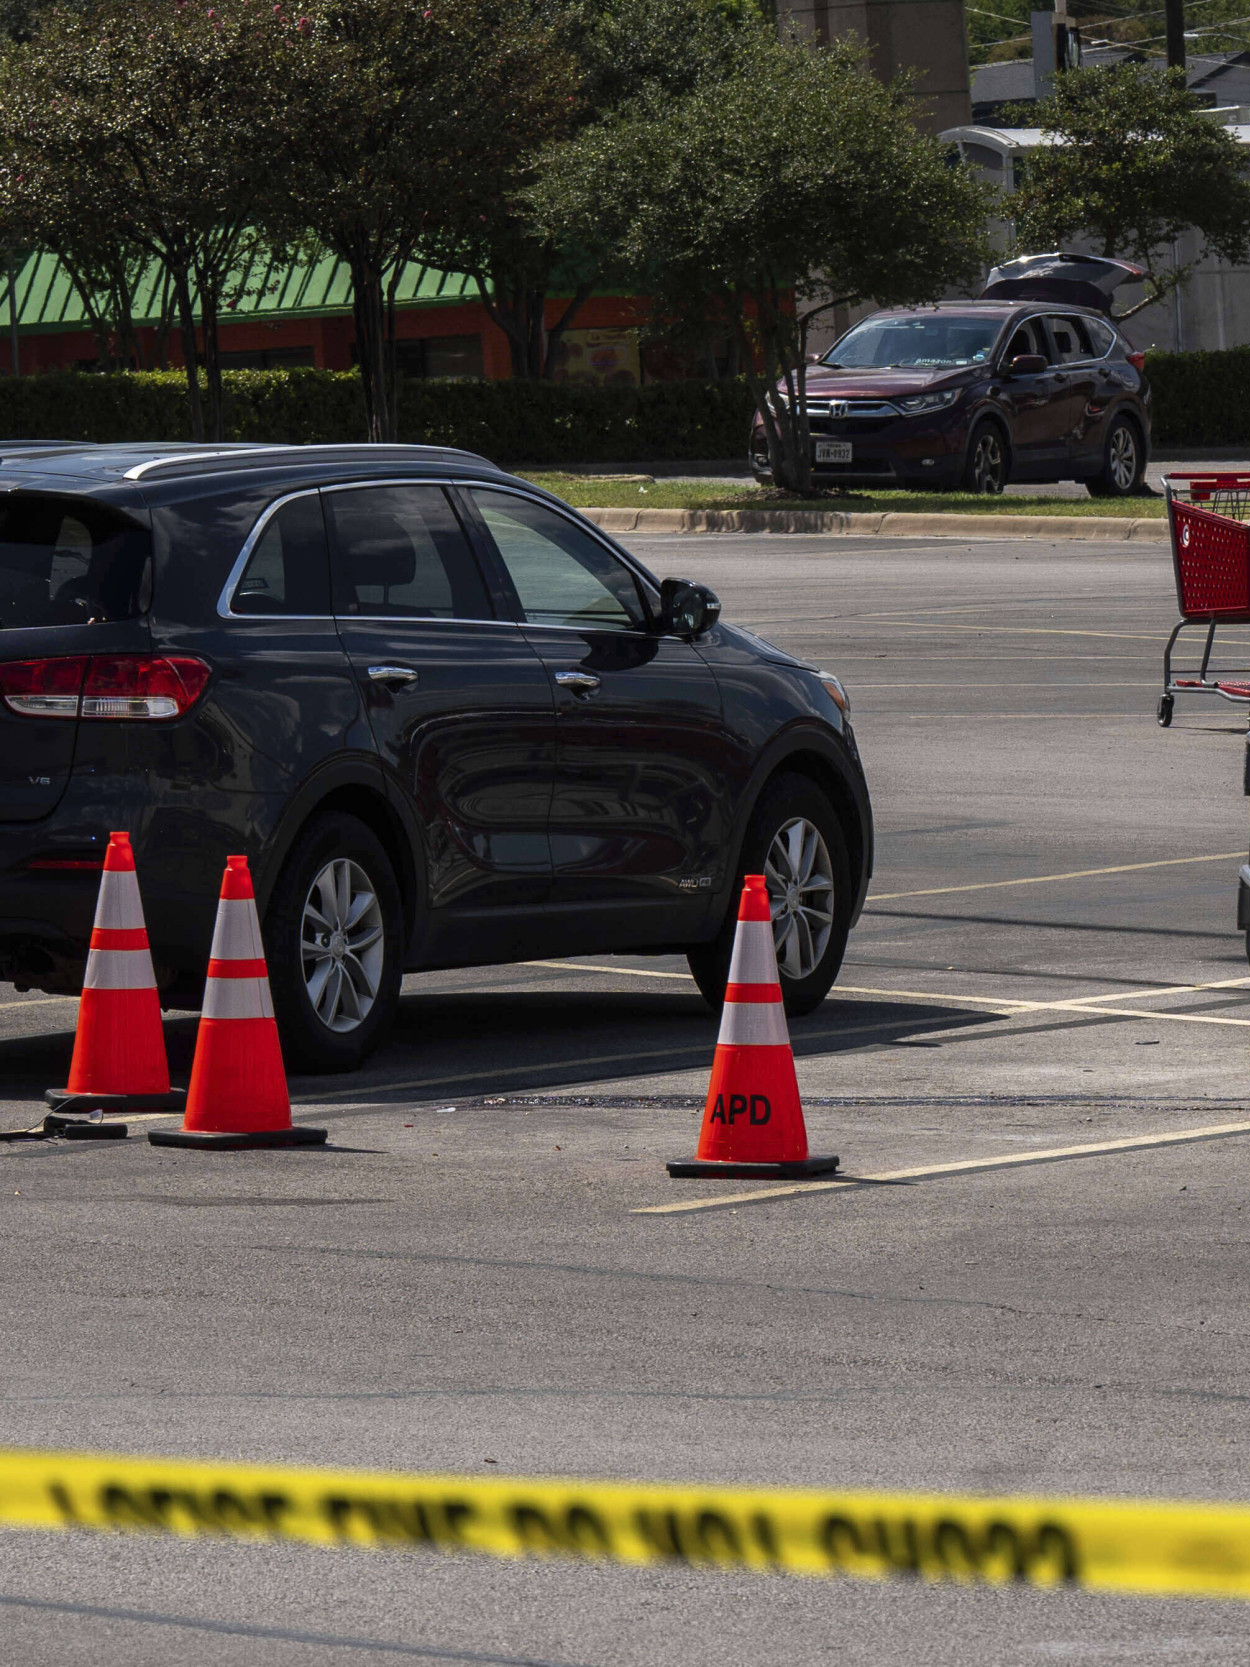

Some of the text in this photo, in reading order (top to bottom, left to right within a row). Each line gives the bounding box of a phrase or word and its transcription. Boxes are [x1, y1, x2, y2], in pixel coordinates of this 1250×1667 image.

[27, 775, 51, 785] V6
[678, 878, 699, 888] AWD
[709, 1093, 771, 1126] APD
